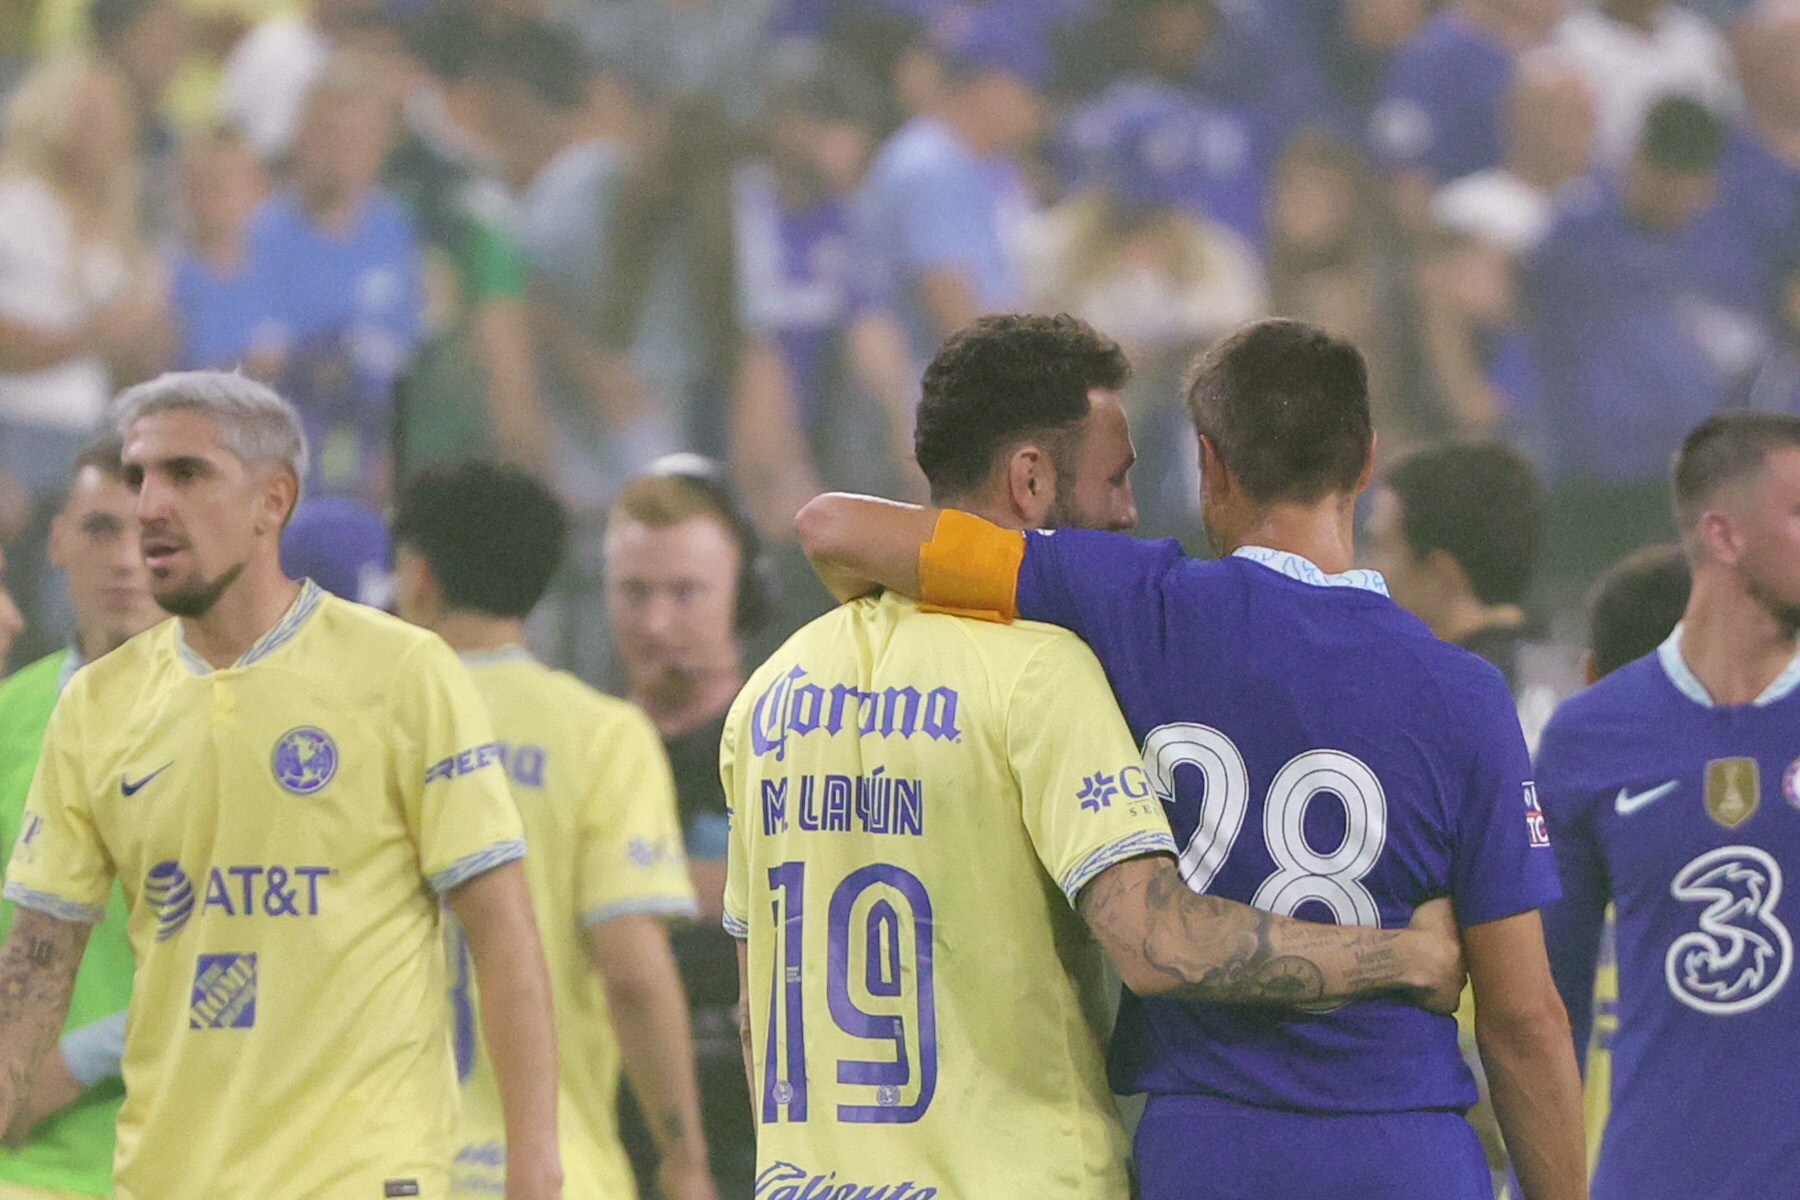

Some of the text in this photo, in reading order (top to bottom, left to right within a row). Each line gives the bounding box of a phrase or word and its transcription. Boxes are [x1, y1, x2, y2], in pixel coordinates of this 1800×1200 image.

[751, 664, 961, 762] Corona
[201, 864, 331, 917] AT&T
[1141, 721, 1388, 929] 28
[761, 860, 938, 1124] 19
[1665, 845, 1793, 1015] 3
